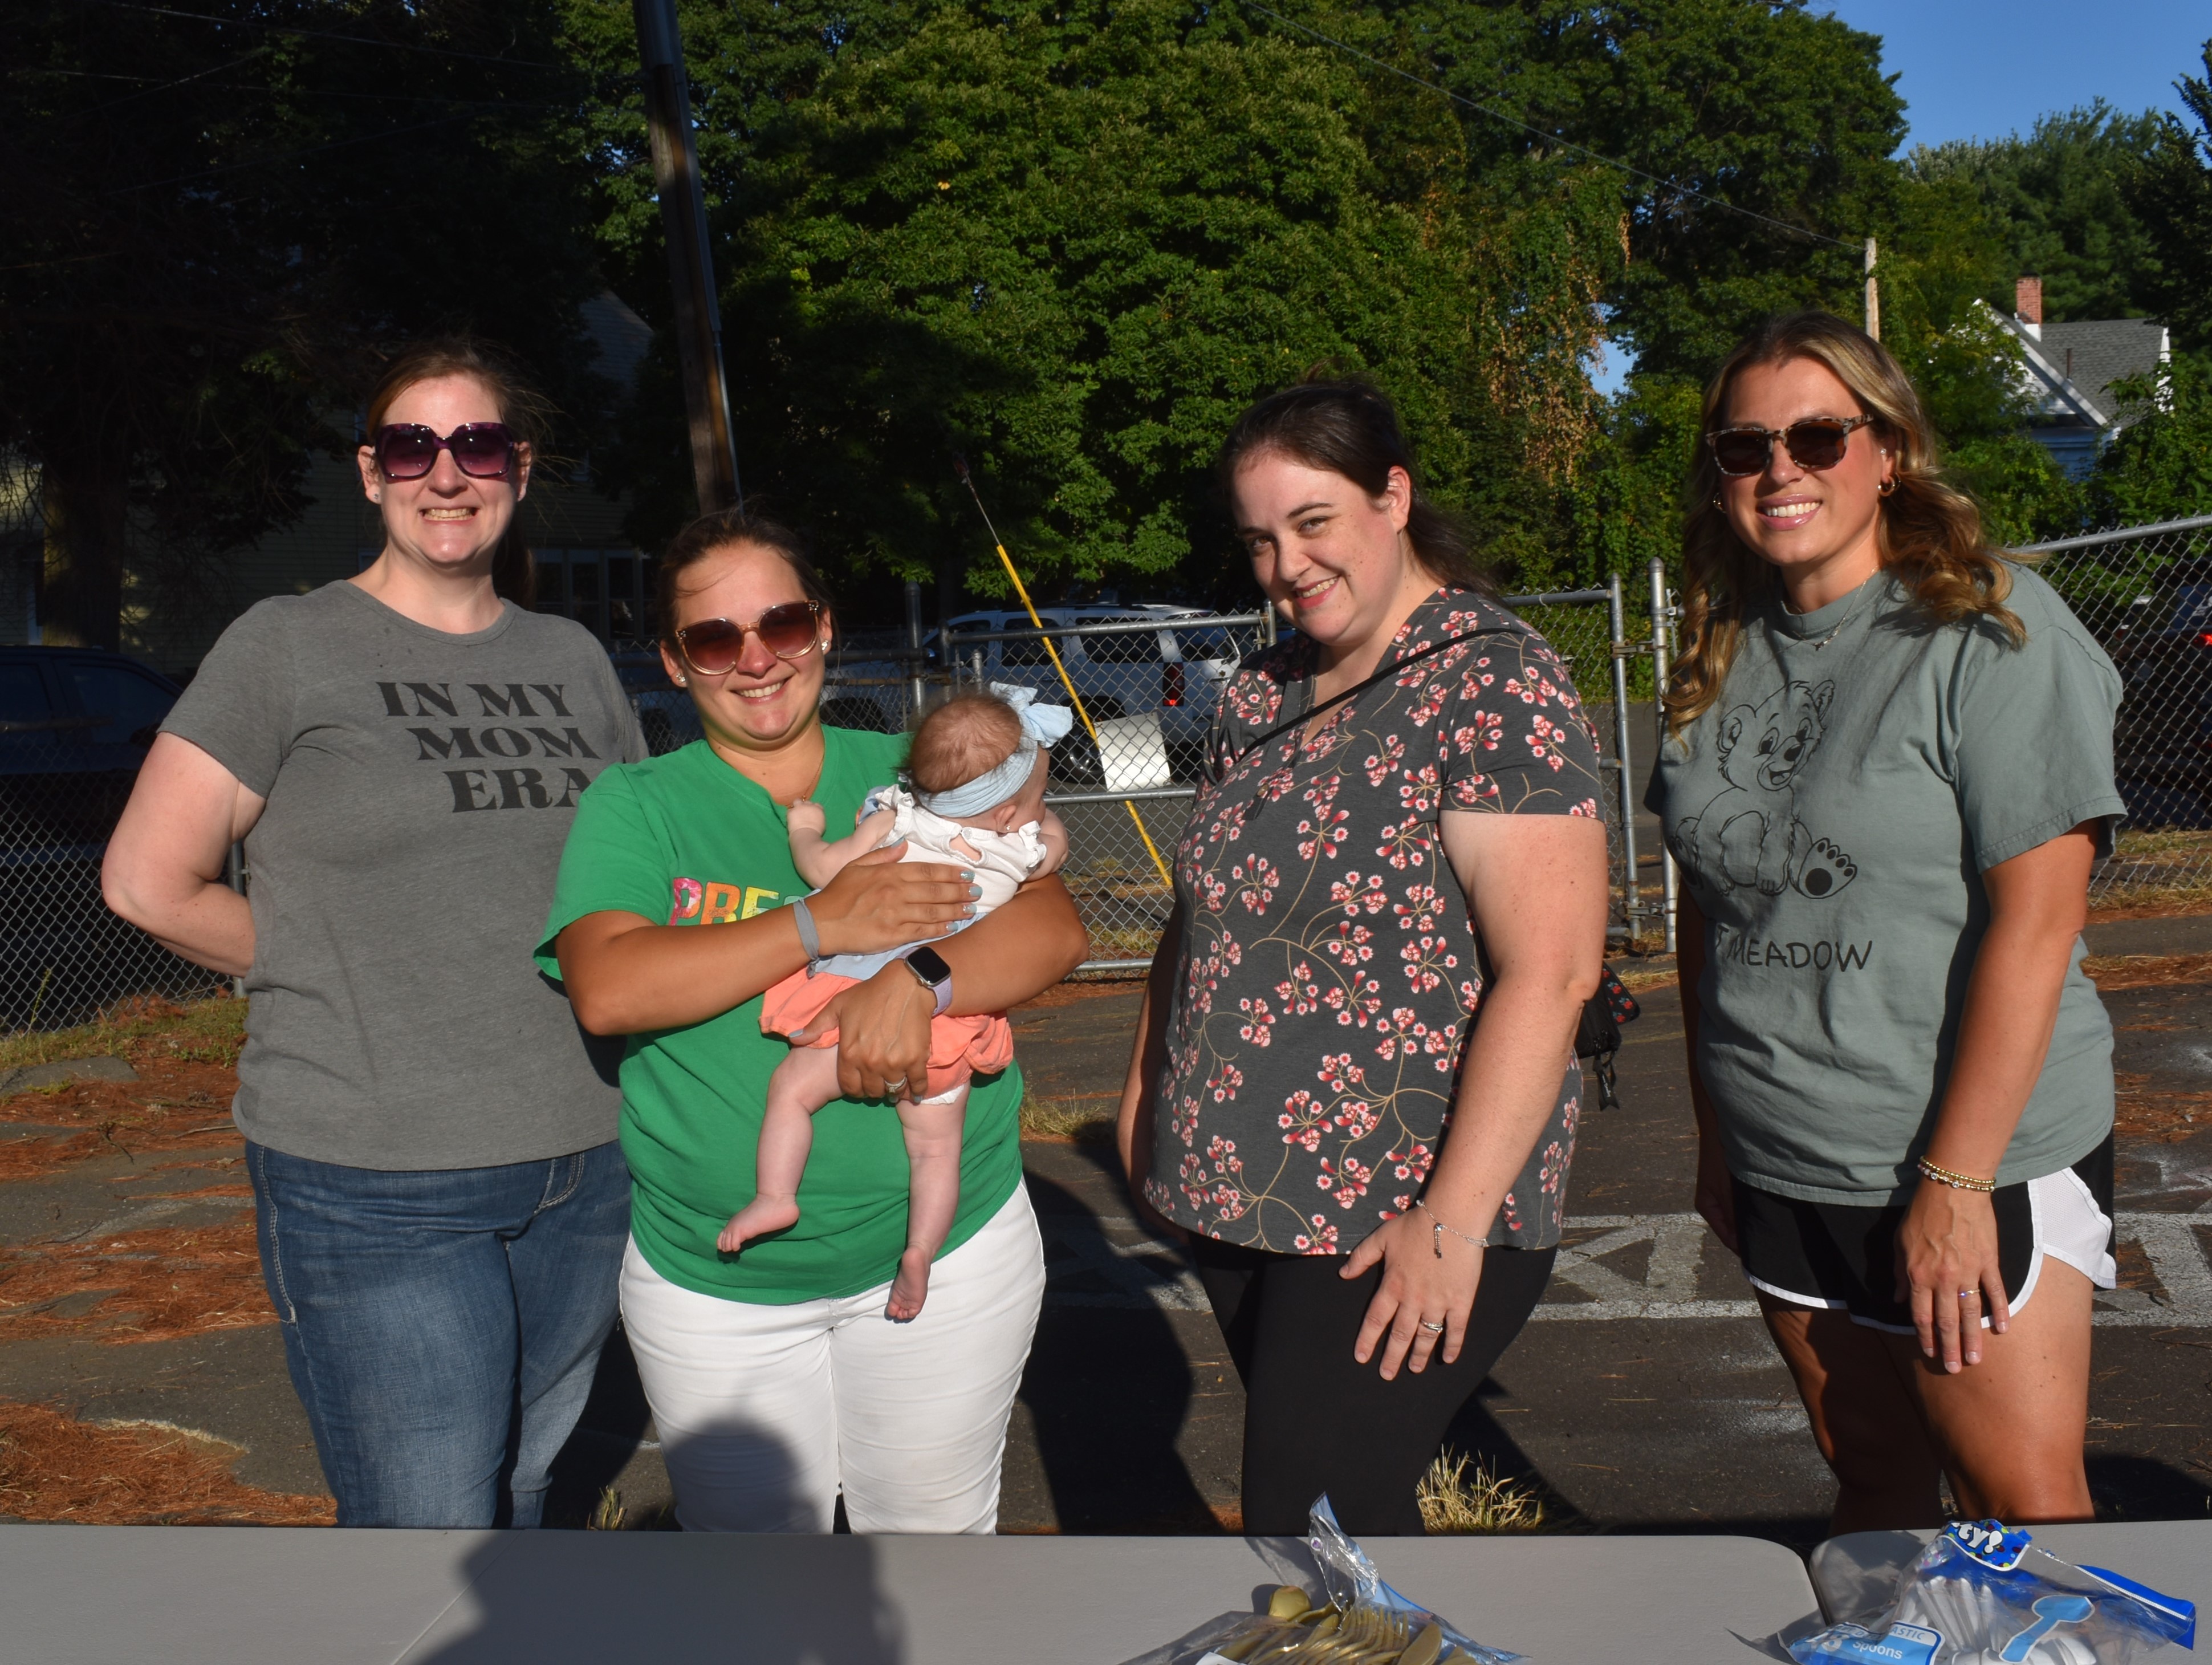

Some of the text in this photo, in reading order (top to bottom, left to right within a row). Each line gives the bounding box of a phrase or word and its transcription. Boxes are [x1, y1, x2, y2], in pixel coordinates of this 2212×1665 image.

[376, 682, 574, 717] IN MY
[405, 727, 602, 760] MOM
[443, 768, 591, 813] ERA
[669, 877, 804, 925] PRE
[1727, 934, 1872, 972] MEADOW
[1950, 1522, 2003, 1553] ty!
[1891, 1626, 1925, 1641] ASTIC
